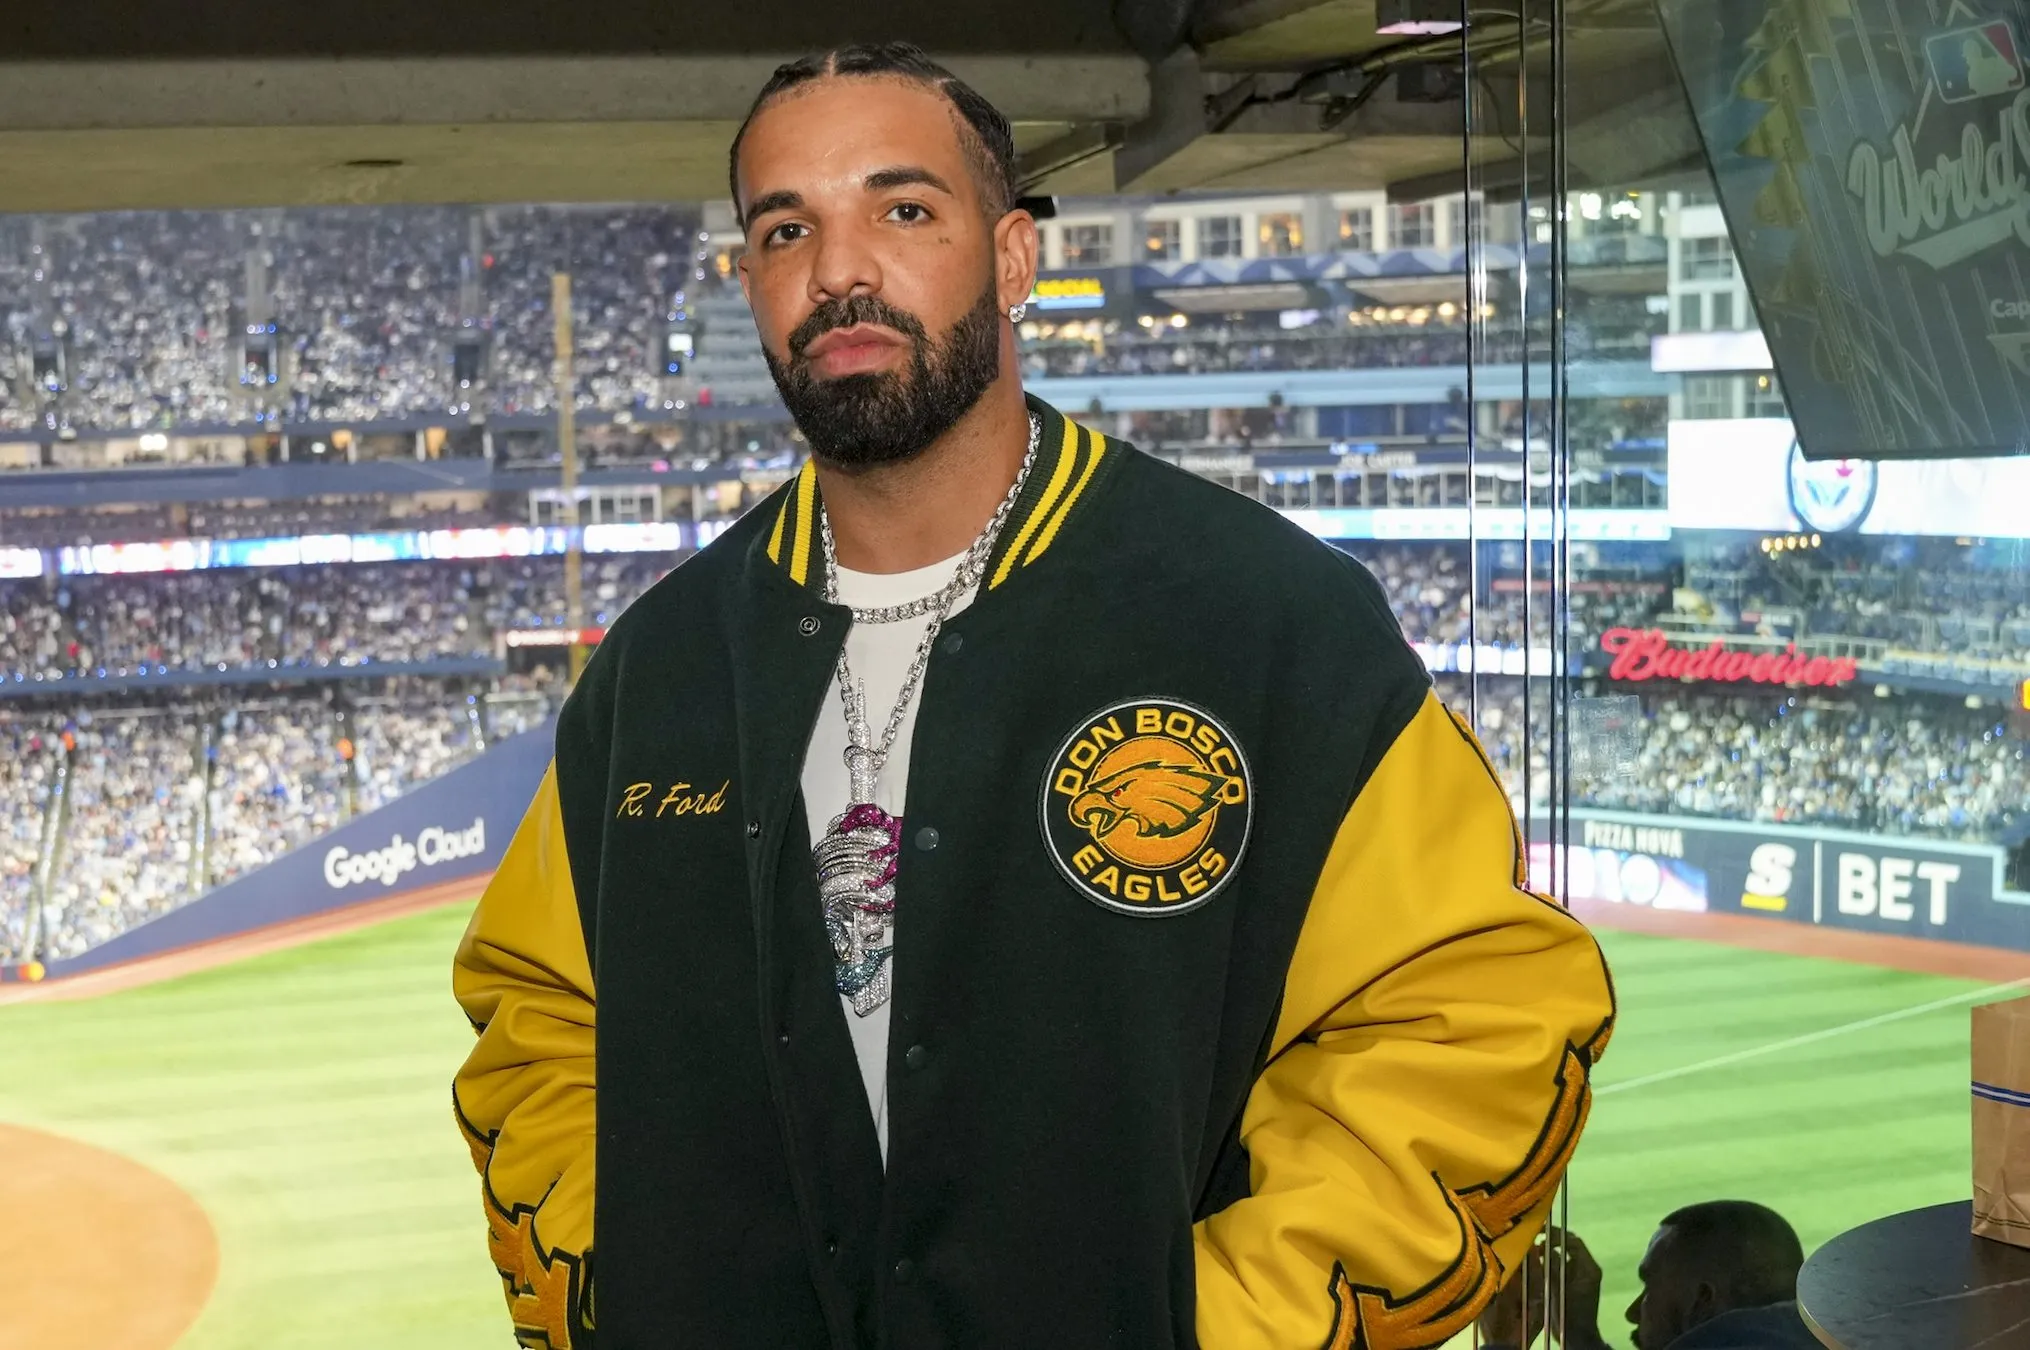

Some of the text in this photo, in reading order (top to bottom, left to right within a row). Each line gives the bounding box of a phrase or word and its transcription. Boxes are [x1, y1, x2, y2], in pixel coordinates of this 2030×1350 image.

[1847, 107, 2024, 258] World
[1601, 627, 1857, 686] Budweiser
[1054, 708, 1246, 805] DON BOSCO
[616, 779, 730, 818] R. Ford
[324, 816, 485, 888] Google Cloud
[1584, 820, 1684, 859] PIZZA NOVA
[1072, 844, 1227, 902] EAGLES
[1745, 842, 1797, 897] S
[1838, 852, 1961, 925] BET
